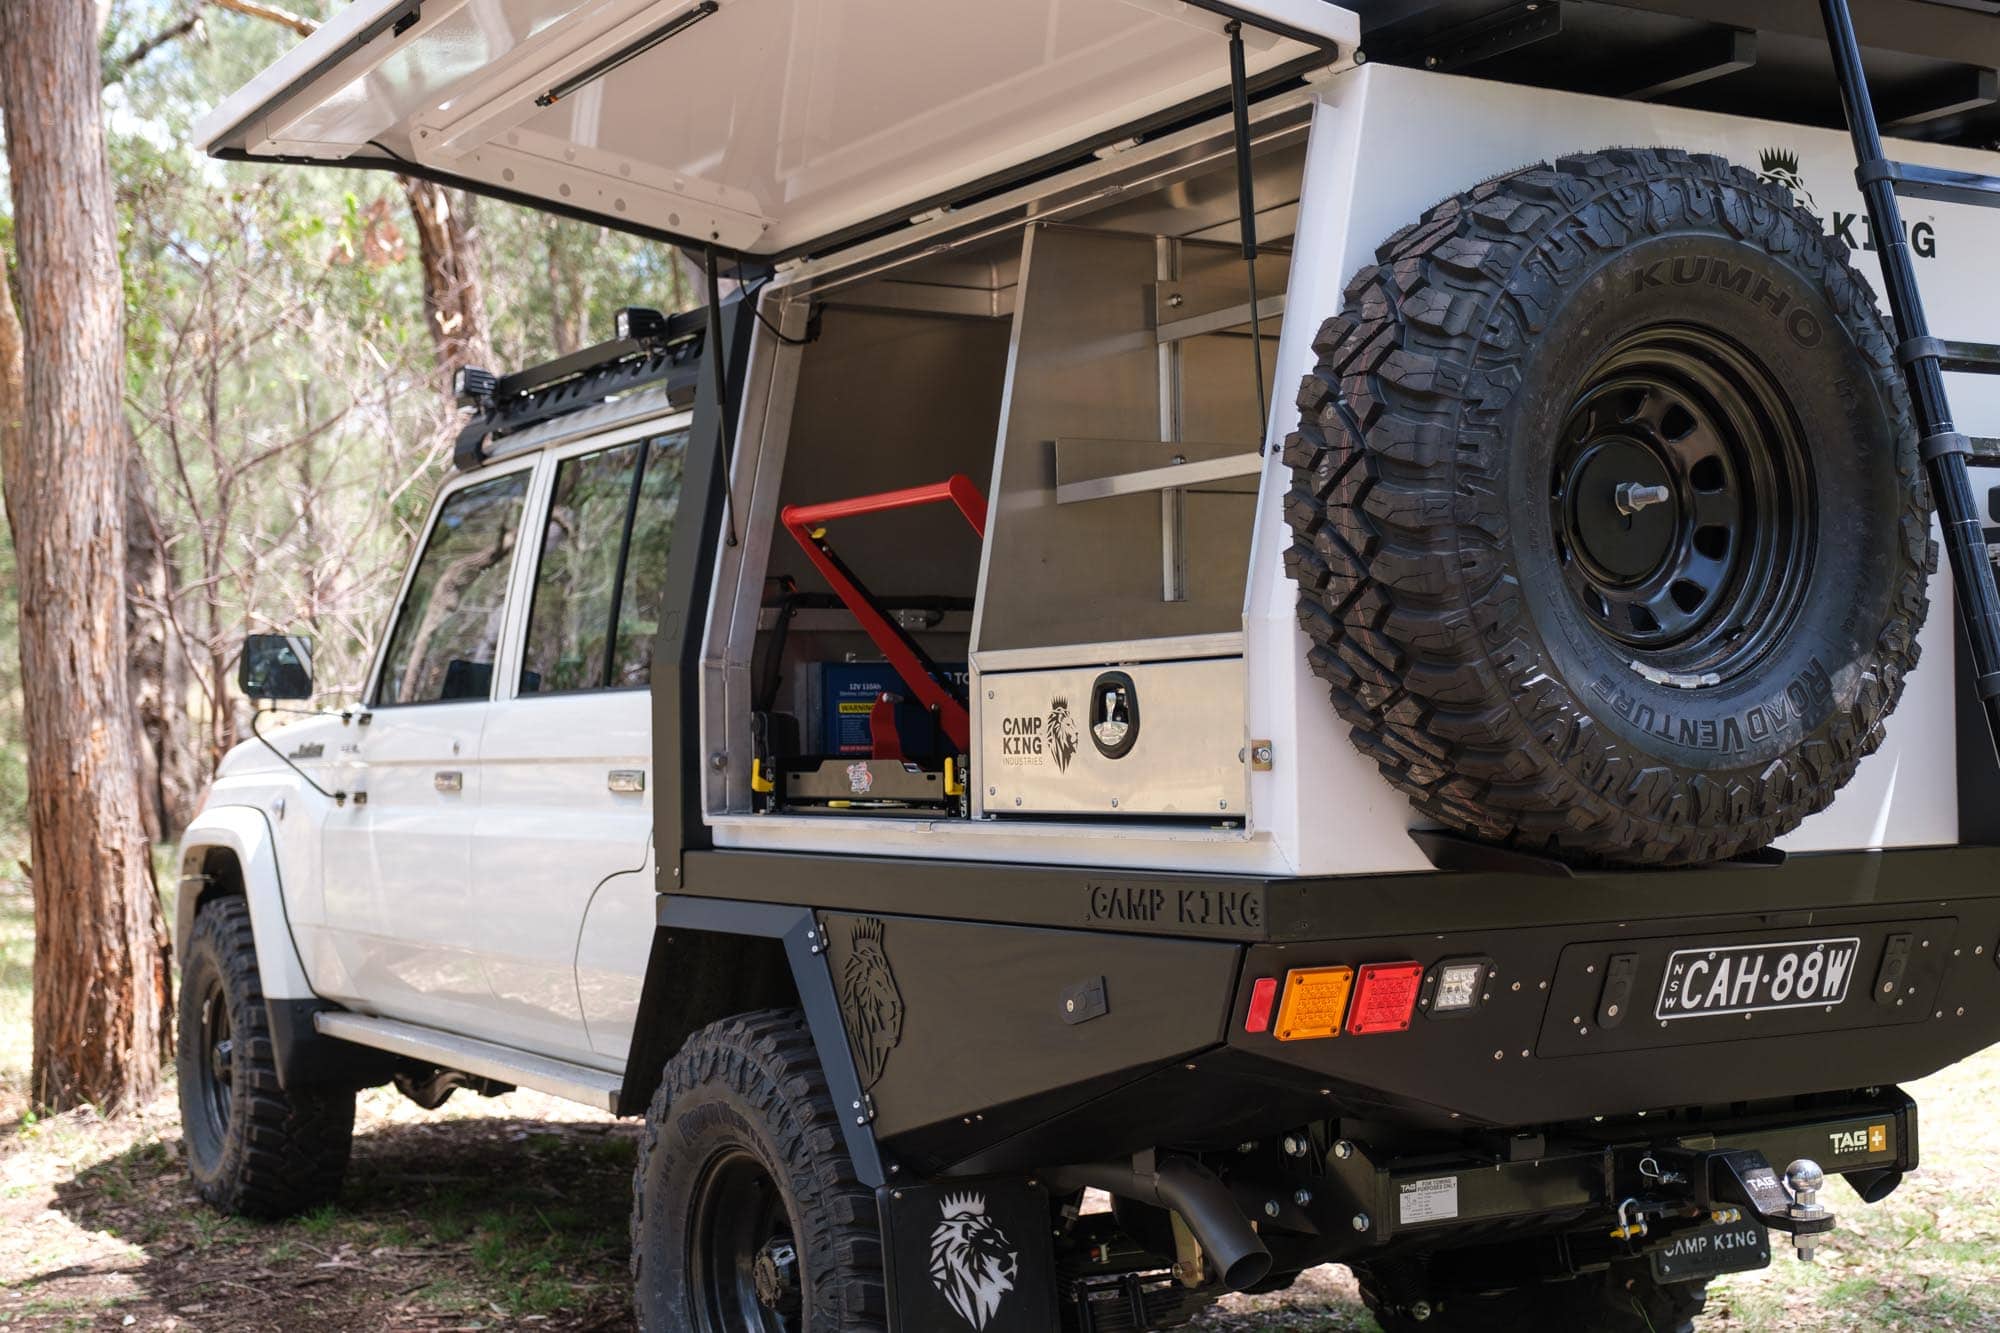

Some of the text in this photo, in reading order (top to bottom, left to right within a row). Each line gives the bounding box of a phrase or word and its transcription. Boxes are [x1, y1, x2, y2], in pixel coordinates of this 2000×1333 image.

[1632, 256, 1824, 348] KUMHO
[1590, 655, 1833, 755] ROADVENTURE
[1003, 717, 1042, 736] CAMP
[1003, 737, 1042, 755] KING
[1002, 757, 1043, 766] INDUSTRIES
[1091, 886, 1261, 927] CAMP KING
[1829, 1130, 1867, 1154] TAG
[1746, 1177, 1776, 1191] TAG
[1714, 1230, 1757, 1250] KING
